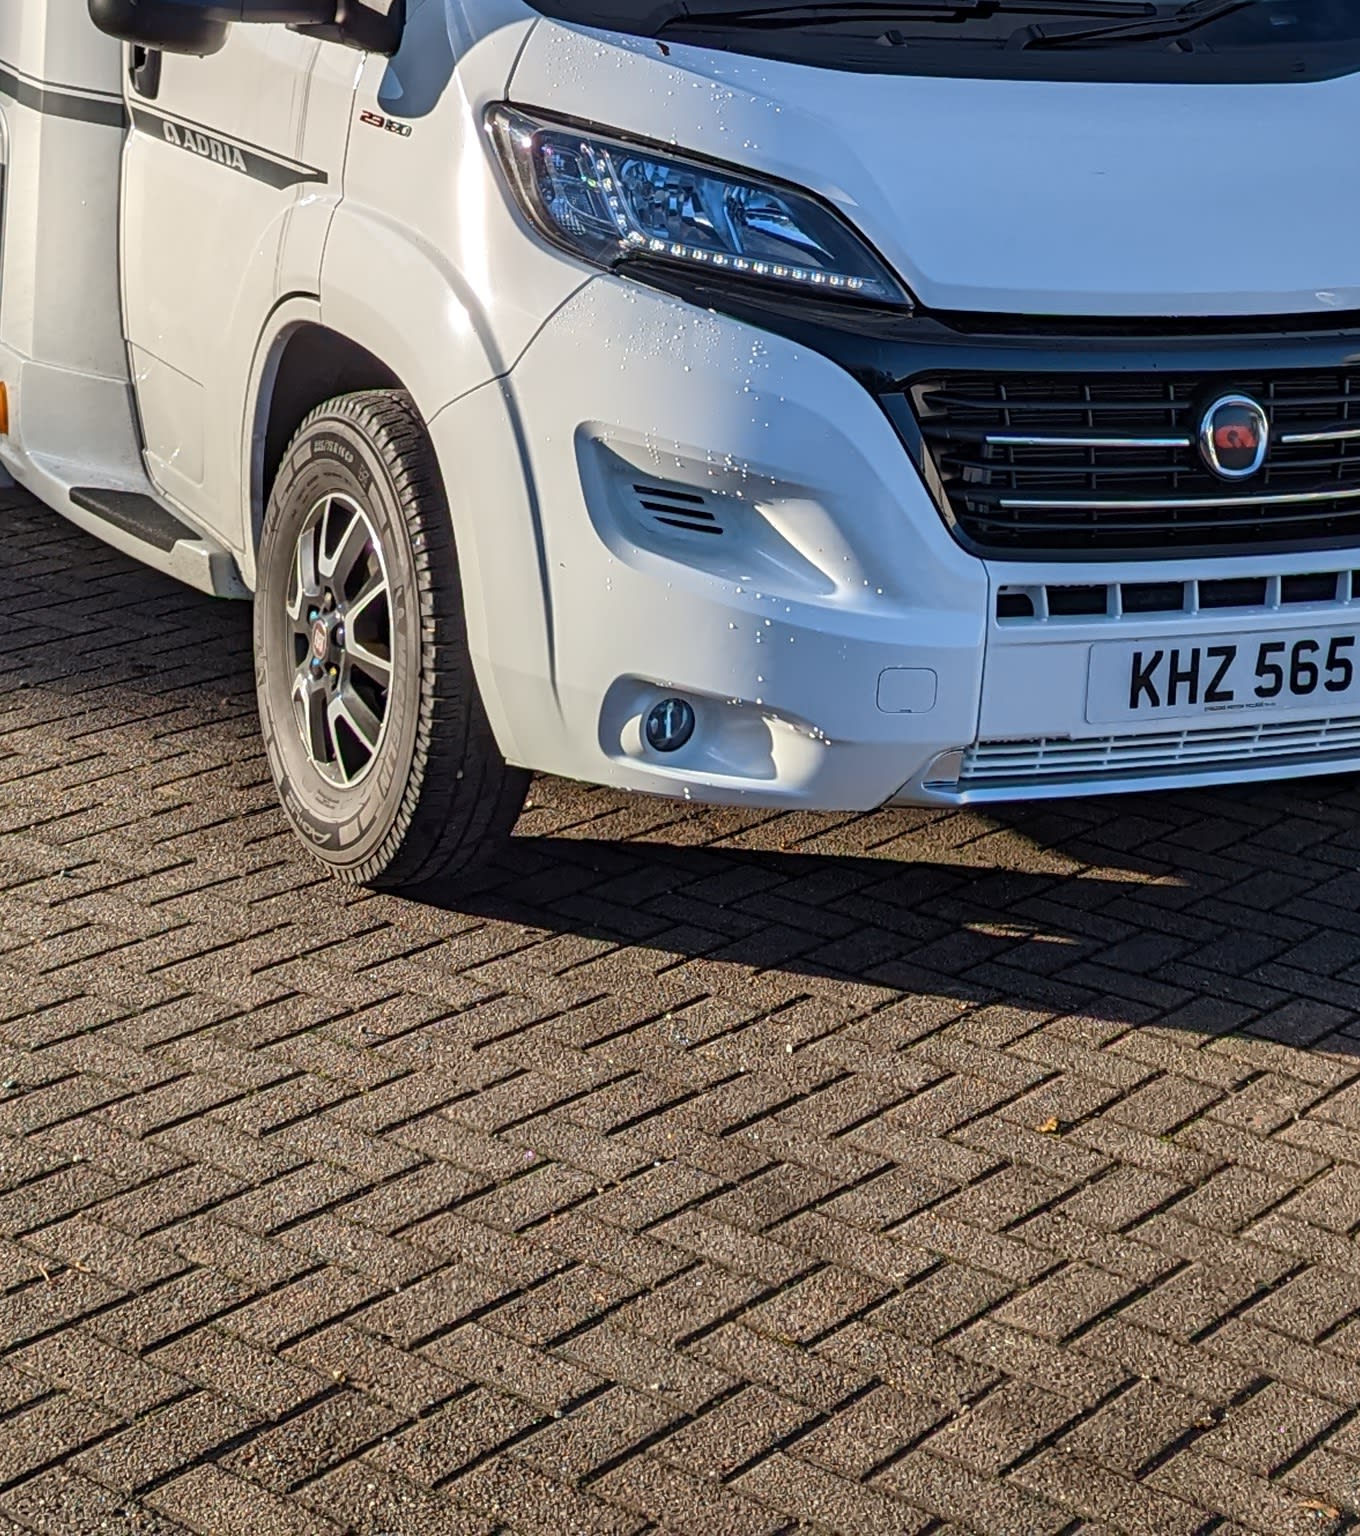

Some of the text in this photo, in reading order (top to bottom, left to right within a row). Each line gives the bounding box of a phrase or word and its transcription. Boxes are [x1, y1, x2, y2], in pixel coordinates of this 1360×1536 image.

[183, 130, 248, 173] ADRIA
[1129, 635, 1356, 709] KHZ 565
